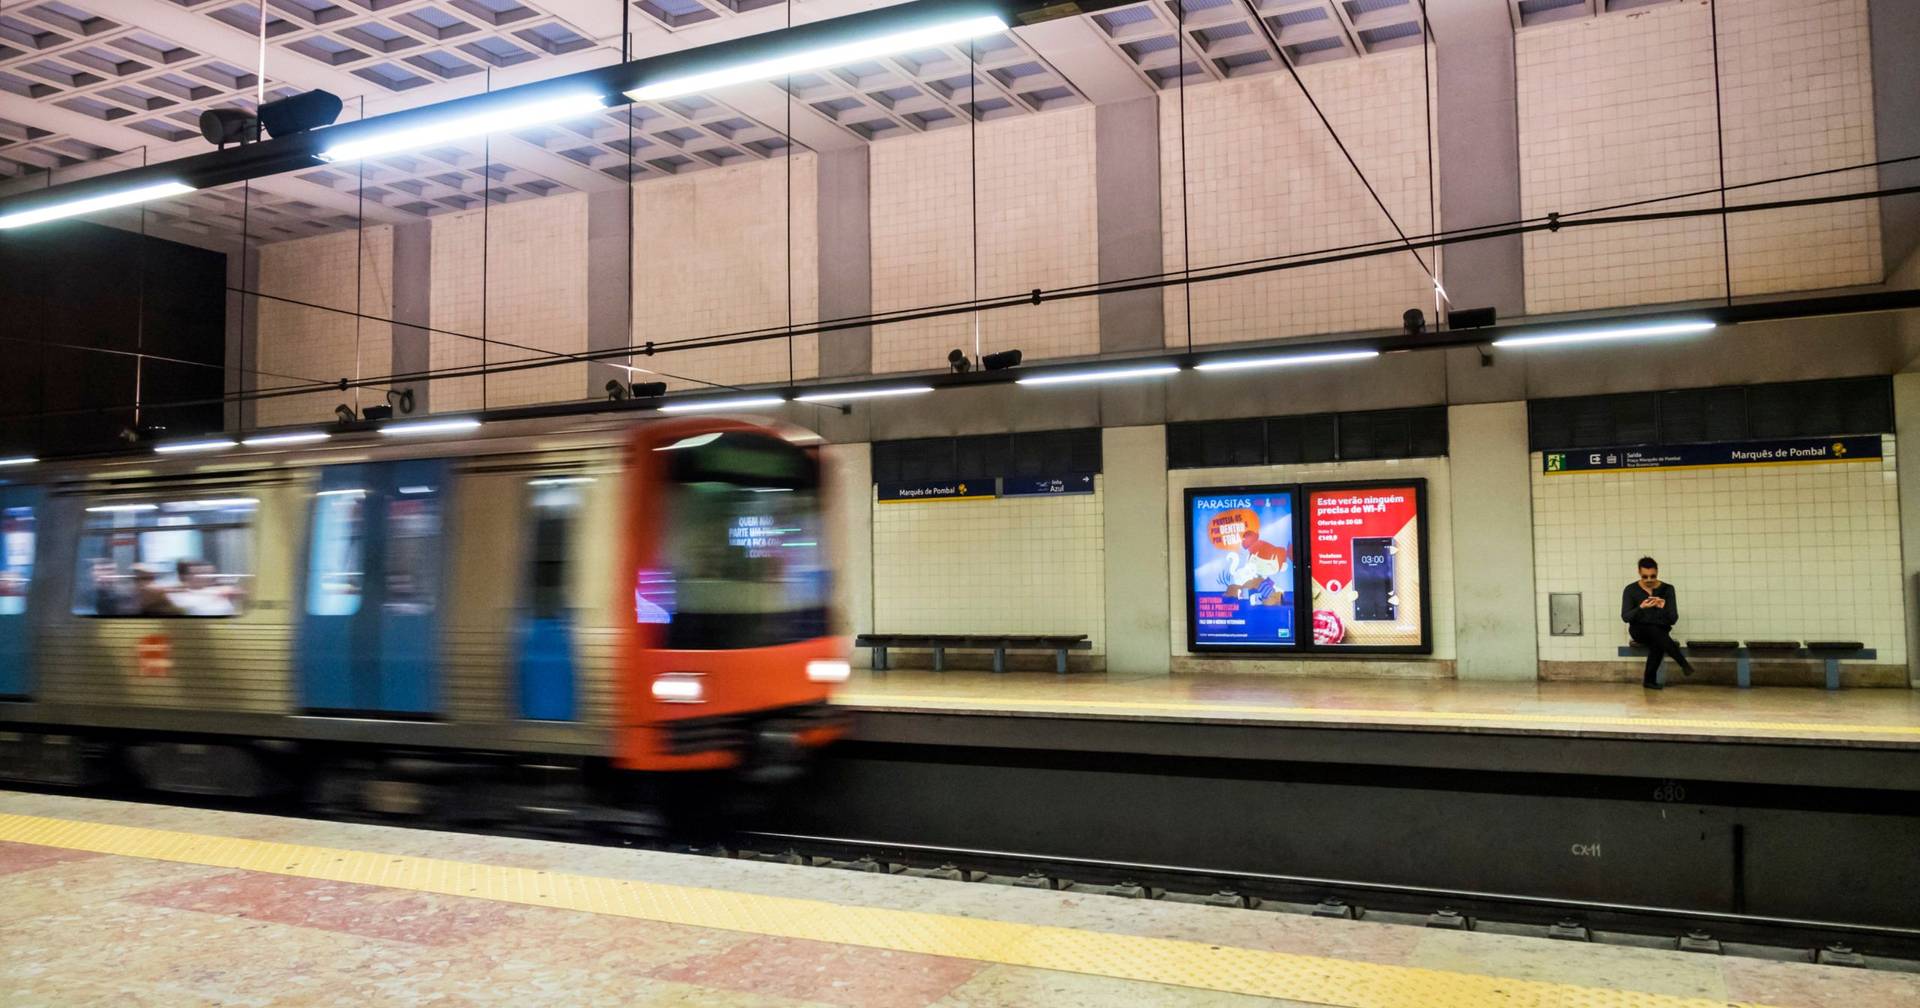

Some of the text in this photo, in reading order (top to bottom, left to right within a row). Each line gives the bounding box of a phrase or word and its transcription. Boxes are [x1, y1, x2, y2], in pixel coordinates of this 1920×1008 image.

[1732, 446, 1826, 460] Marquês de Pombal
[899, 486, 956, 497] Marquês de Pombal
[1050, 484, 1064, 492] Azul
[1317, 495, 1404, 506] Este verão ninguém
[1317, 505, 1349, 516] precisa
[1350, 504, 1362, 513] de
[1362, 555, 1385, 563] 03:00
[1653, 785, 1685, 801] 680
[1571, 843, 1601, 856] CX-11
